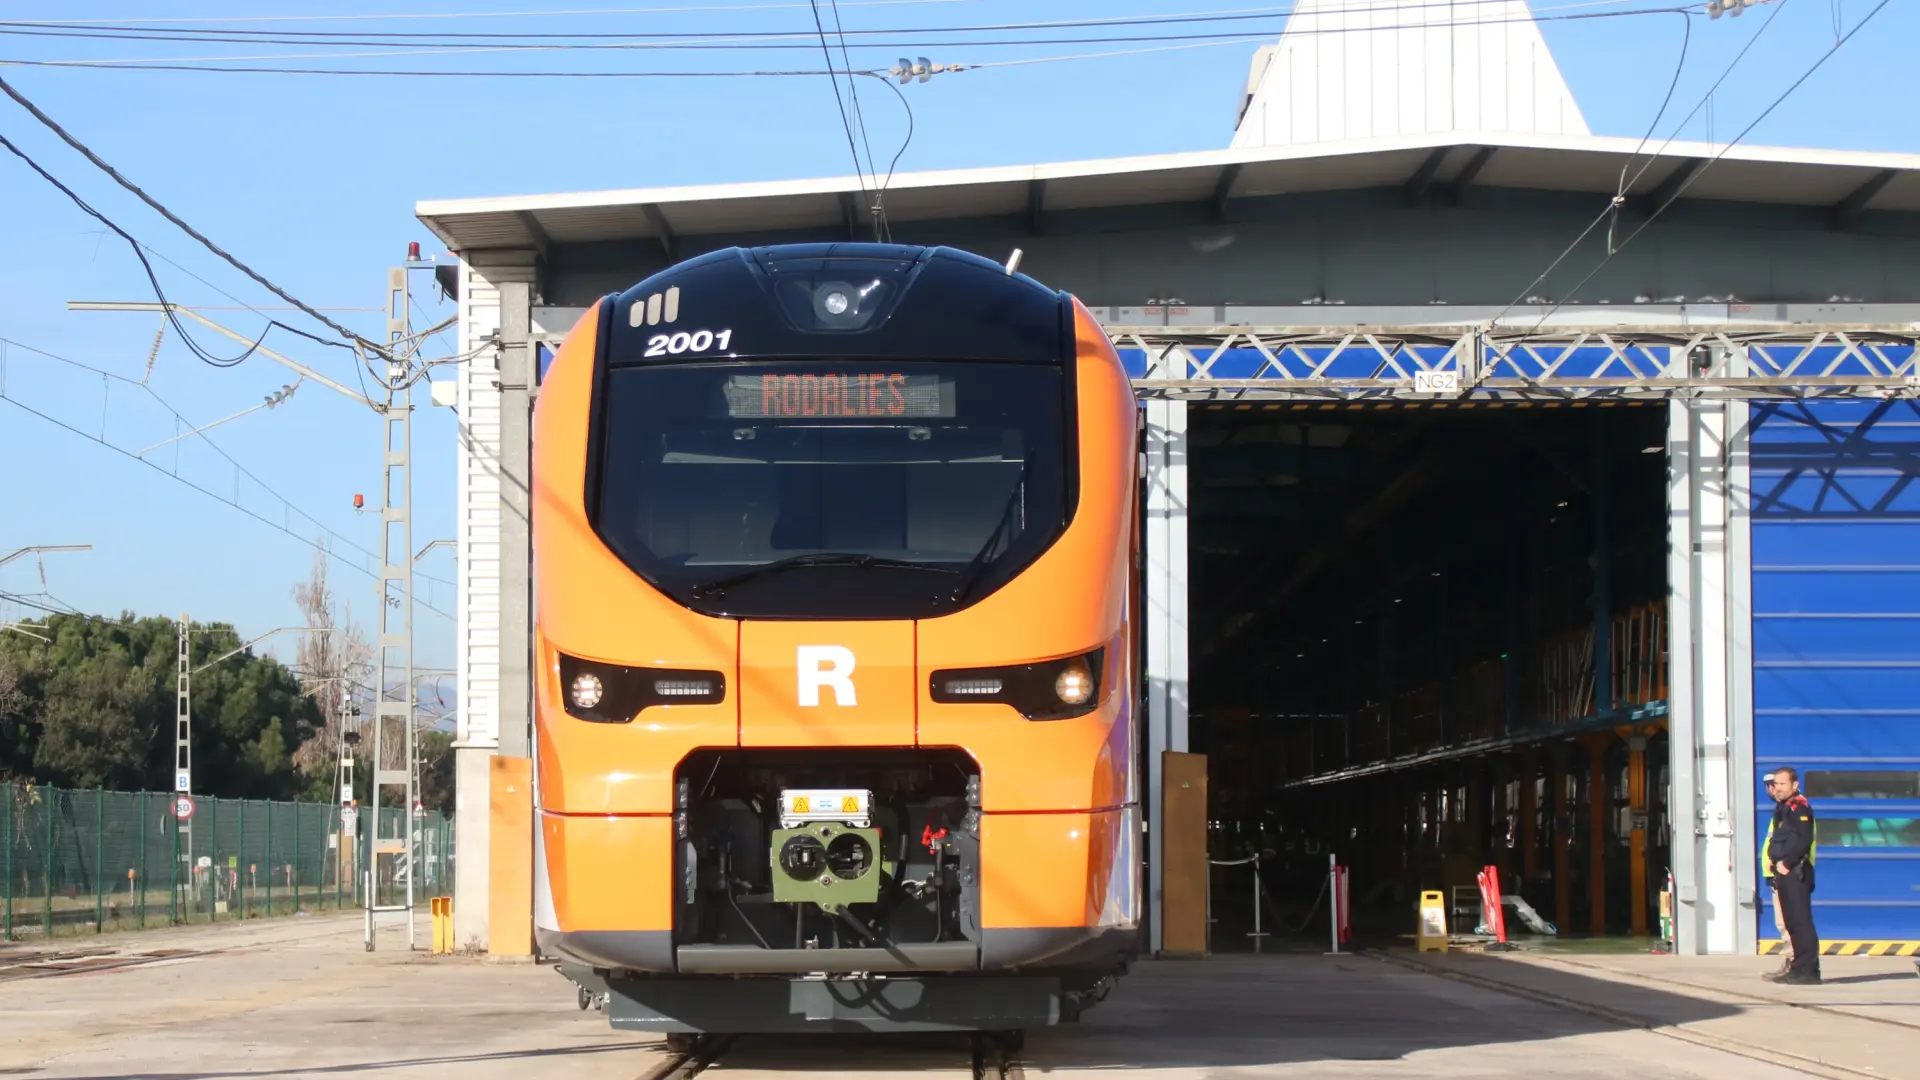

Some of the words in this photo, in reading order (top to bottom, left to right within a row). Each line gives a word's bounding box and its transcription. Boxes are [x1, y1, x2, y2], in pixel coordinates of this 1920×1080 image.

[643, 329, 732, 357] 2001
[761, 373, 906, 416] RODALIES
[1418, 374, 1454, 389] NG2
[797, 645, 858, 707] R
[179, 776, 187, 788] B
